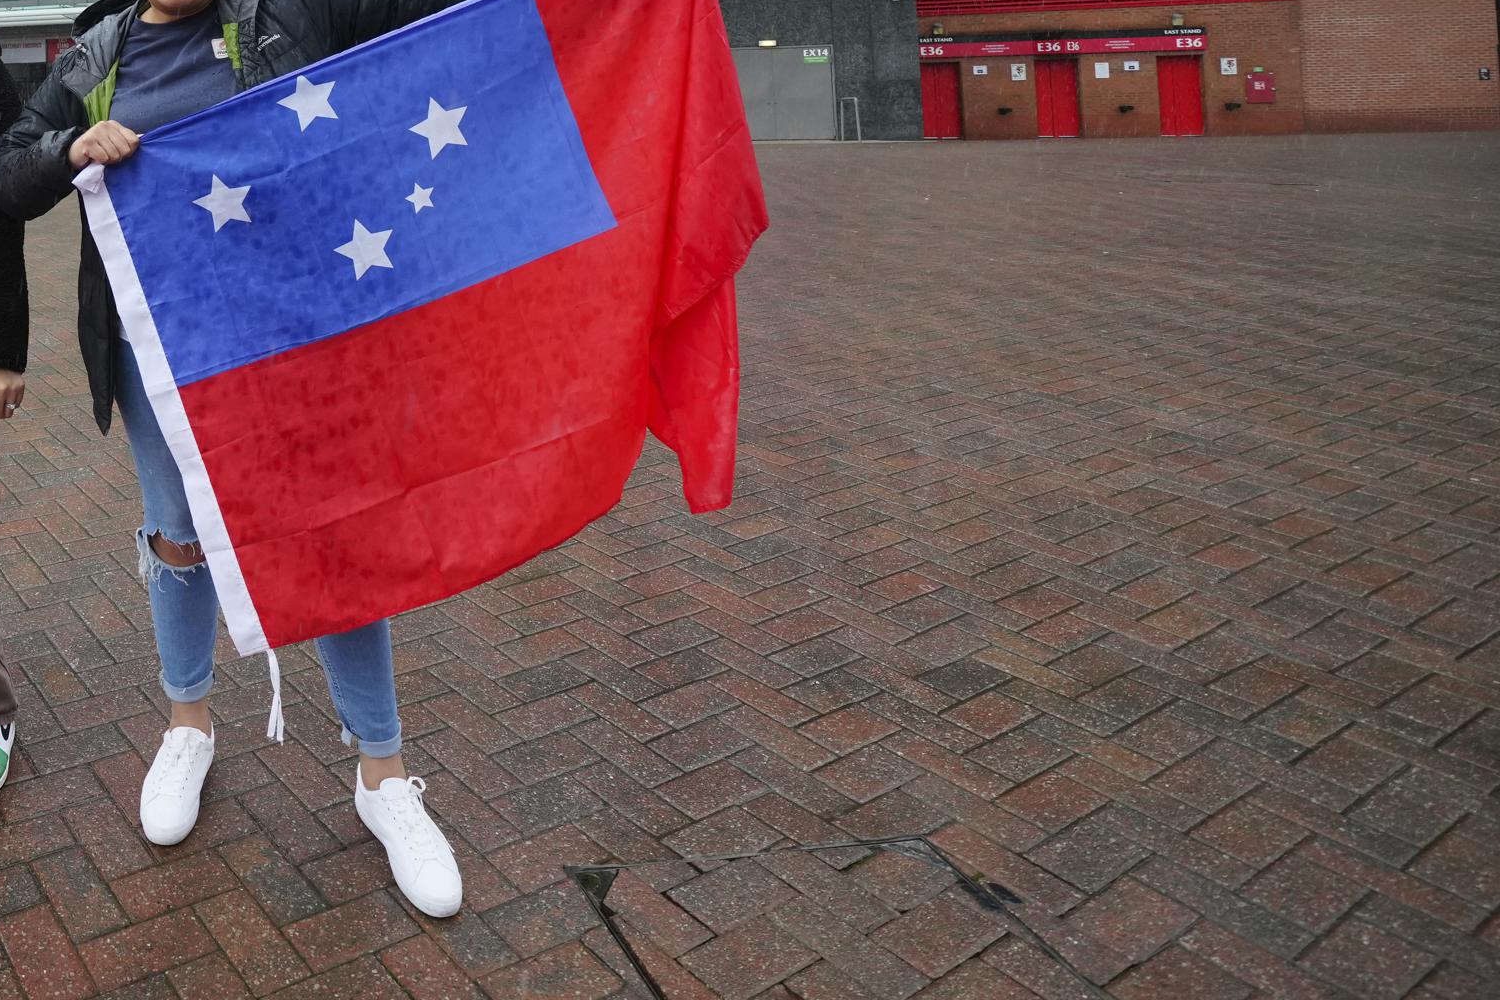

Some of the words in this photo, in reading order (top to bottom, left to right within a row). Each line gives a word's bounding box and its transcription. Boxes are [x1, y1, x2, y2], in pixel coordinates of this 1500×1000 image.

[1037, 42, 1061, 52] E36
[1176, 38, 1202, 48] E36
[803, 48, 828, 56] EX14
[920, 46, 944, 56] E36
